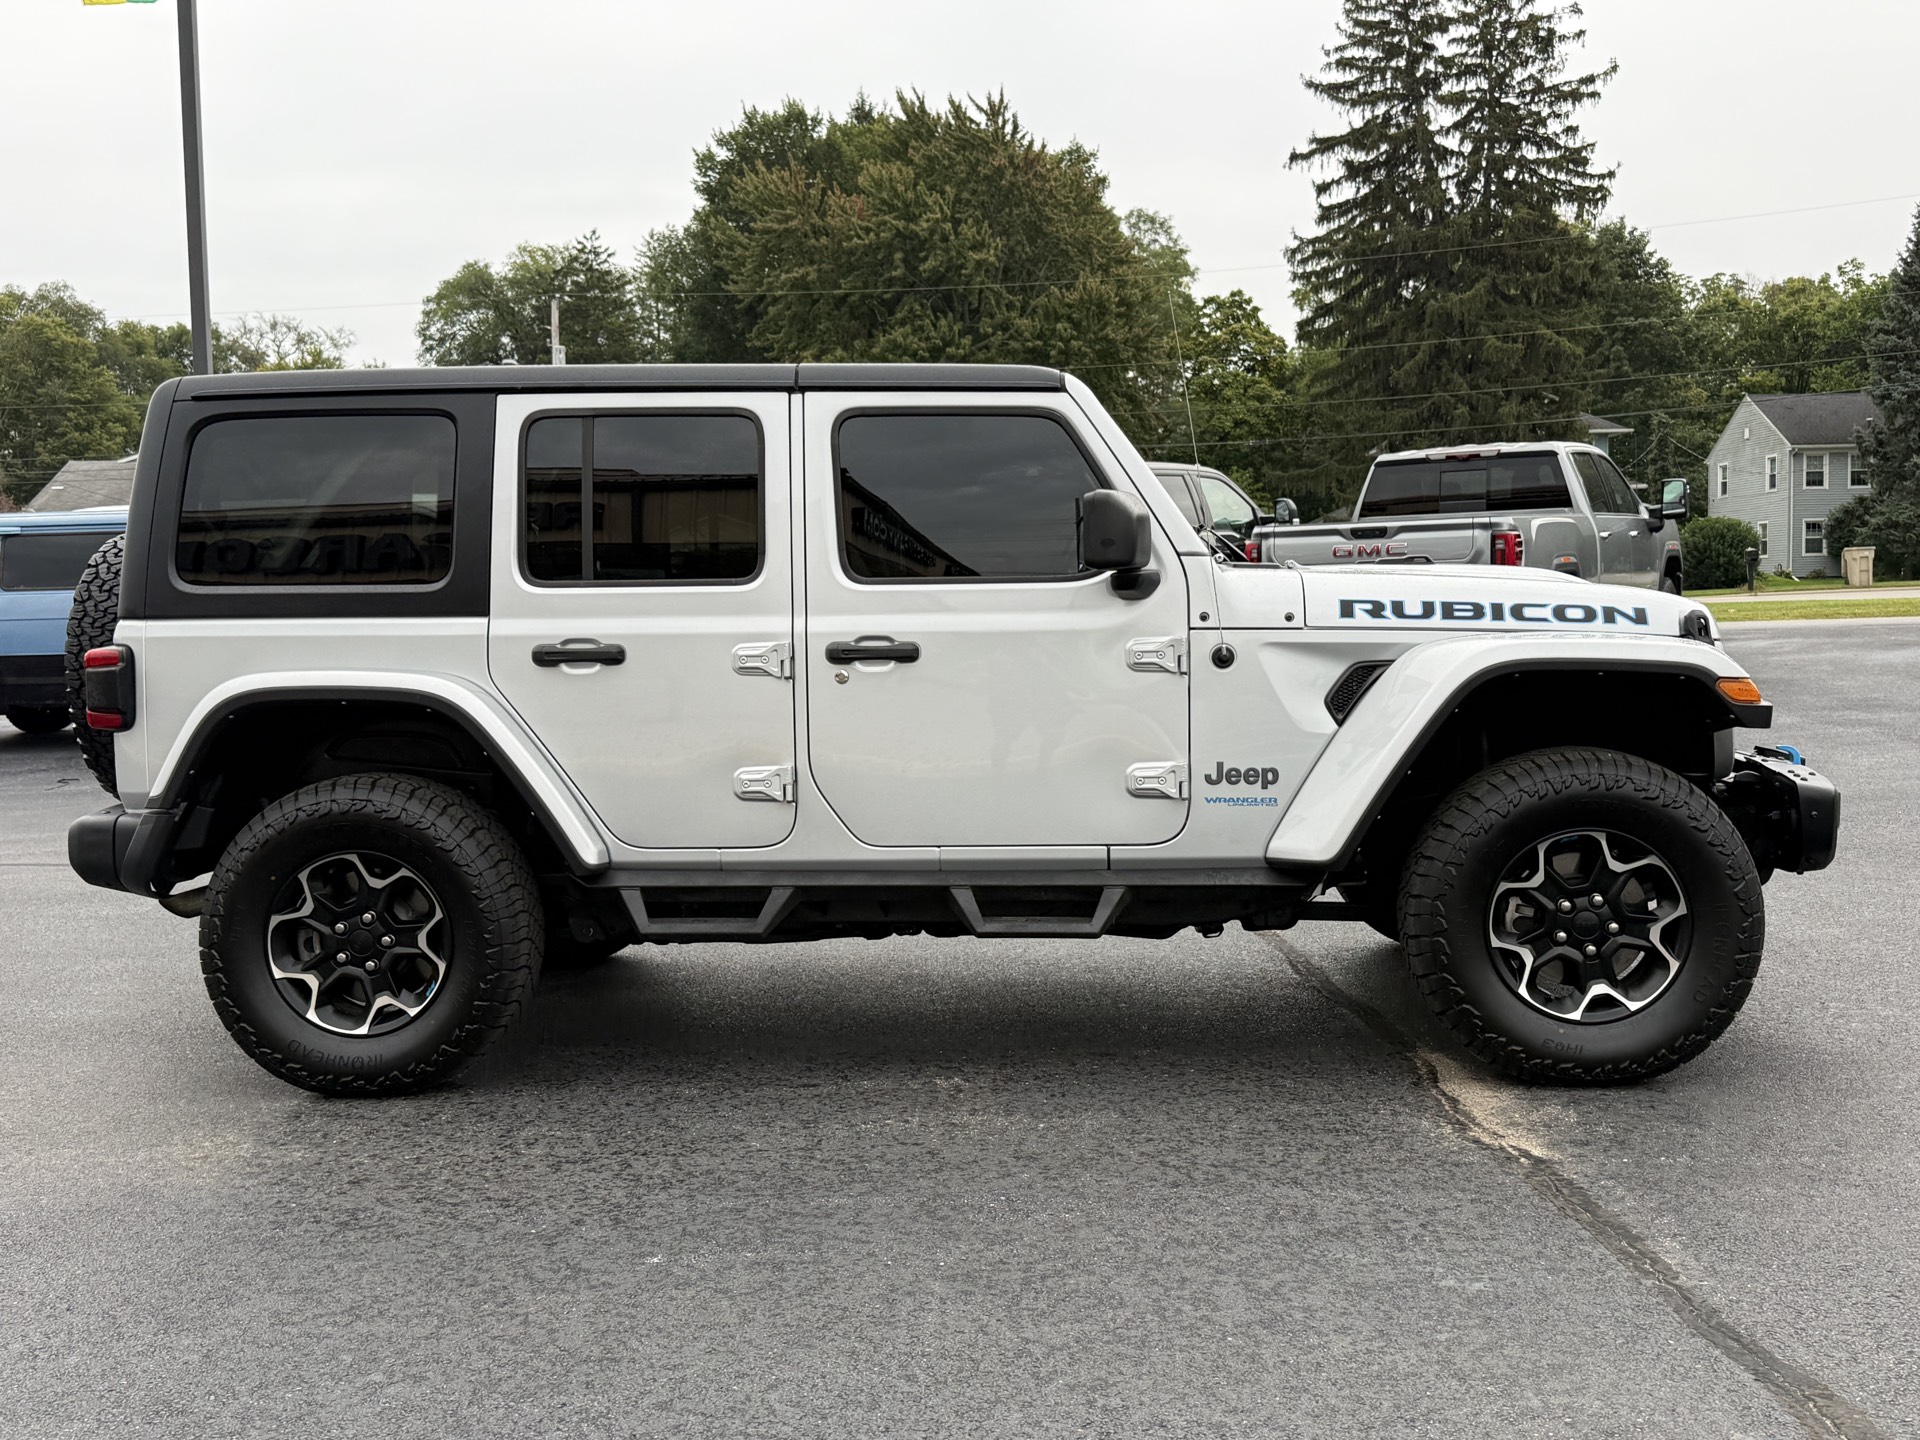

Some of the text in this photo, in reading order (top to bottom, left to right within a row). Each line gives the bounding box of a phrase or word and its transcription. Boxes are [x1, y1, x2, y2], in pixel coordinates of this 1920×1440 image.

[1332, 542, 1408, 558] GMC
[1338, 598, 1650, 627] RUBICON
[1204, 761, 1280, 790] Jeep
[1204, 796, 1278, 804] WRANGLER
[287, 1039, 383, 1070] IRONHEAD
